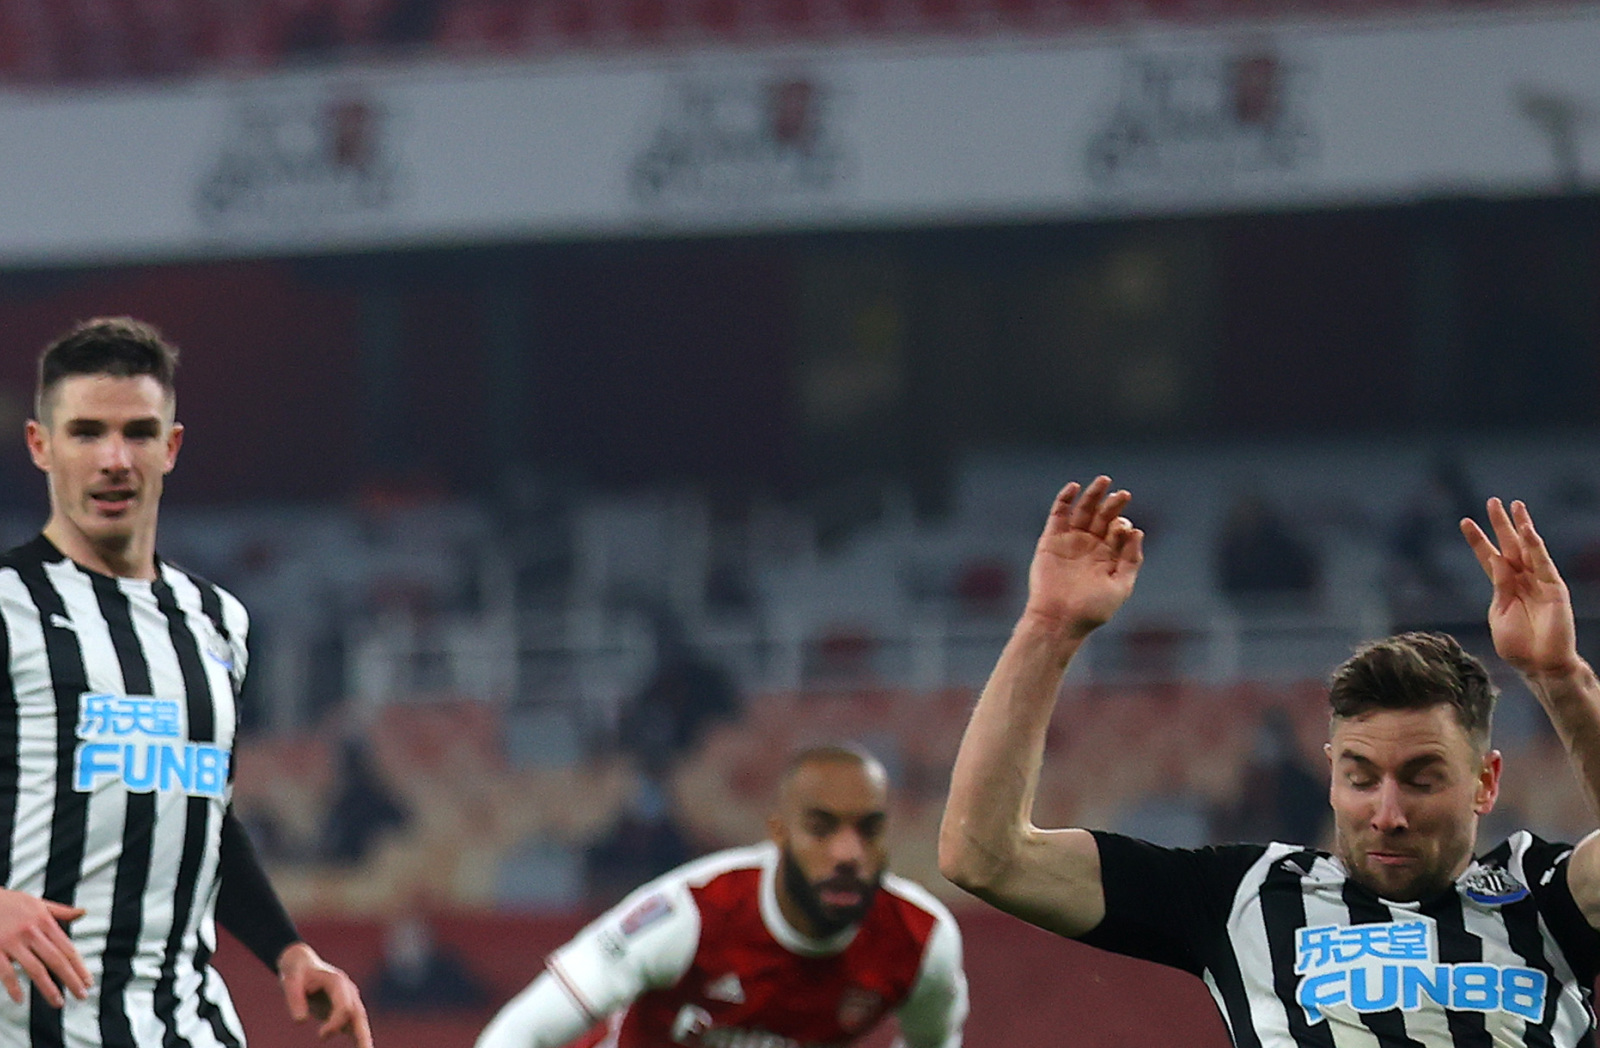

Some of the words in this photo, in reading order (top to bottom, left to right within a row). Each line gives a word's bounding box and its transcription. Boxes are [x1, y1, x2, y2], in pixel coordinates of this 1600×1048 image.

[82, 694, 180, 738] 乐天堂
[79, 743, 230, 795] FUN8
[1298, 922, 1428, 971] 乐天堂
[1300, 965, 1546, 1021] FUN88
